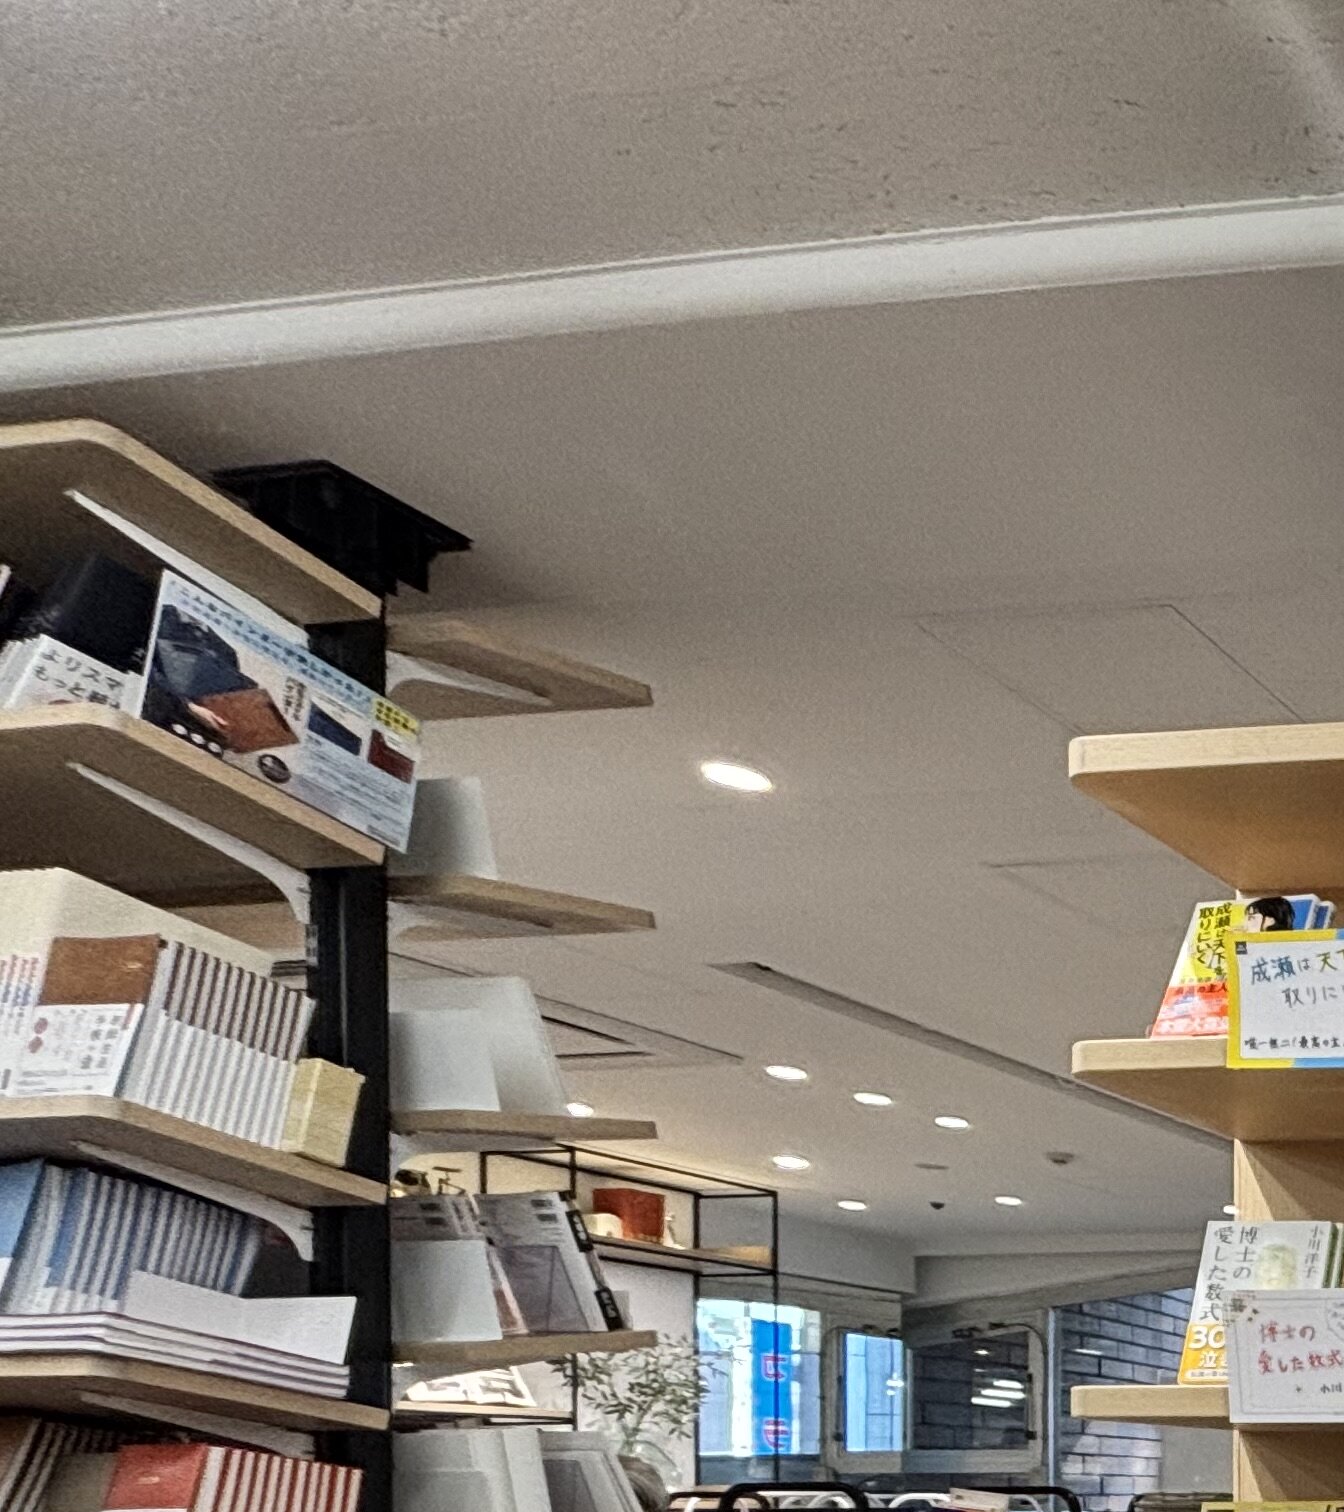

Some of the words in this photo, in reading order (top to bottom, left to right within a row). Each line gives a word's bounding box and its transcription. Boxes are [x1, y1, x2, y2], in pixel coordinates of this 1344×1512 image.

[1199, 1226, 1235, 1322] 愛した数式
[1232, 1226, 1259, 1281] 博士の
[1302, 1225, 1325, 1280] 小川洋子
[1260, 1321, 1316, 1343] 博士の
[1258, 1350, 1344, 1375] 愛した数式
